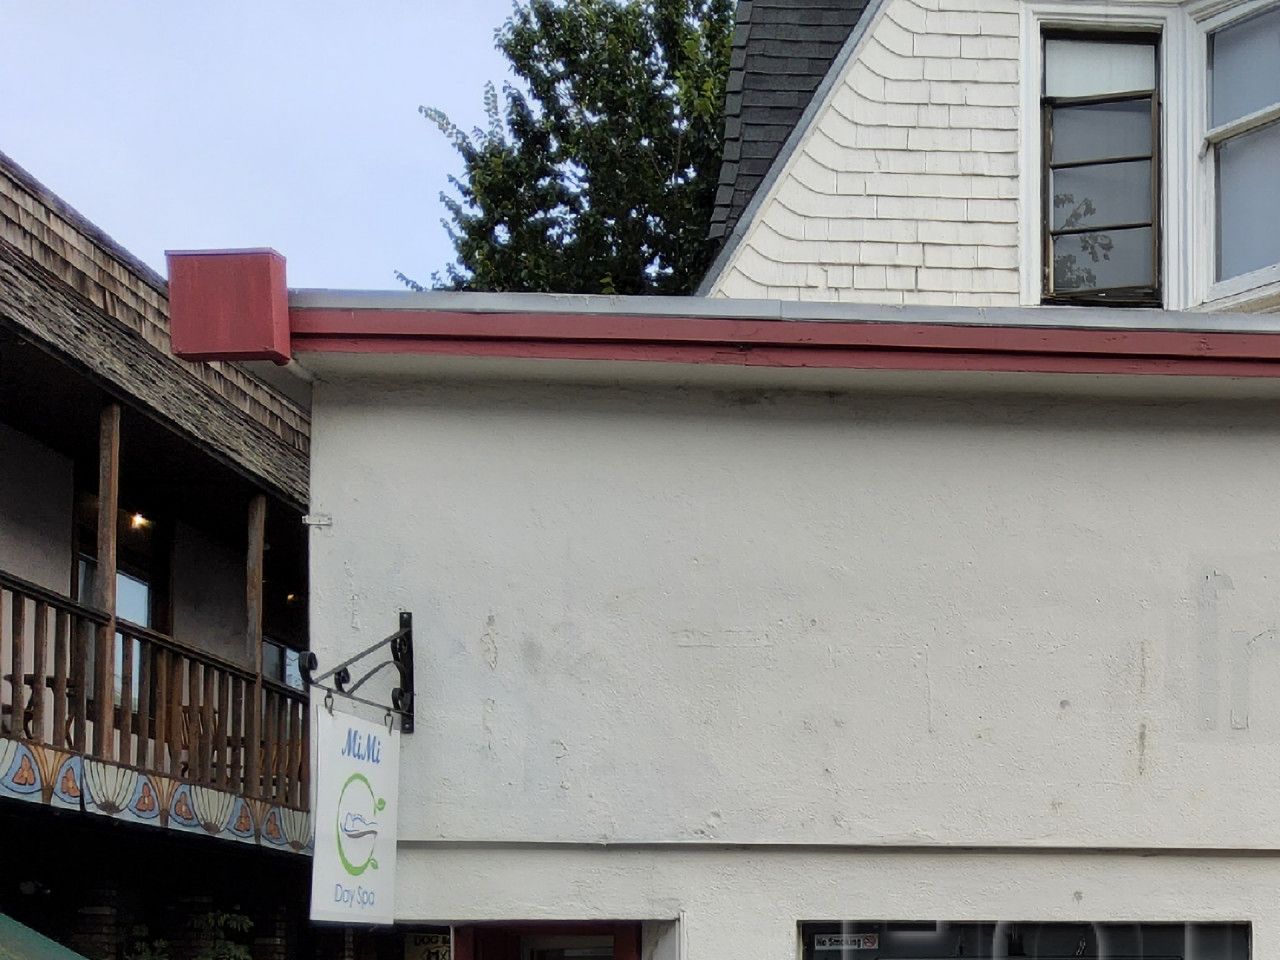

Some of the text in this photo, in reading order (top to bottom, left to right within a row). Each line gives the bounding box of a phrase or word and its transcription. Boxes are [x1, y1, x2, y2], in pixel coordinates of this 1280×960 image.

[341, 727, 381, 764] MiMi
[334, 883, 376, 909] Day Spa
